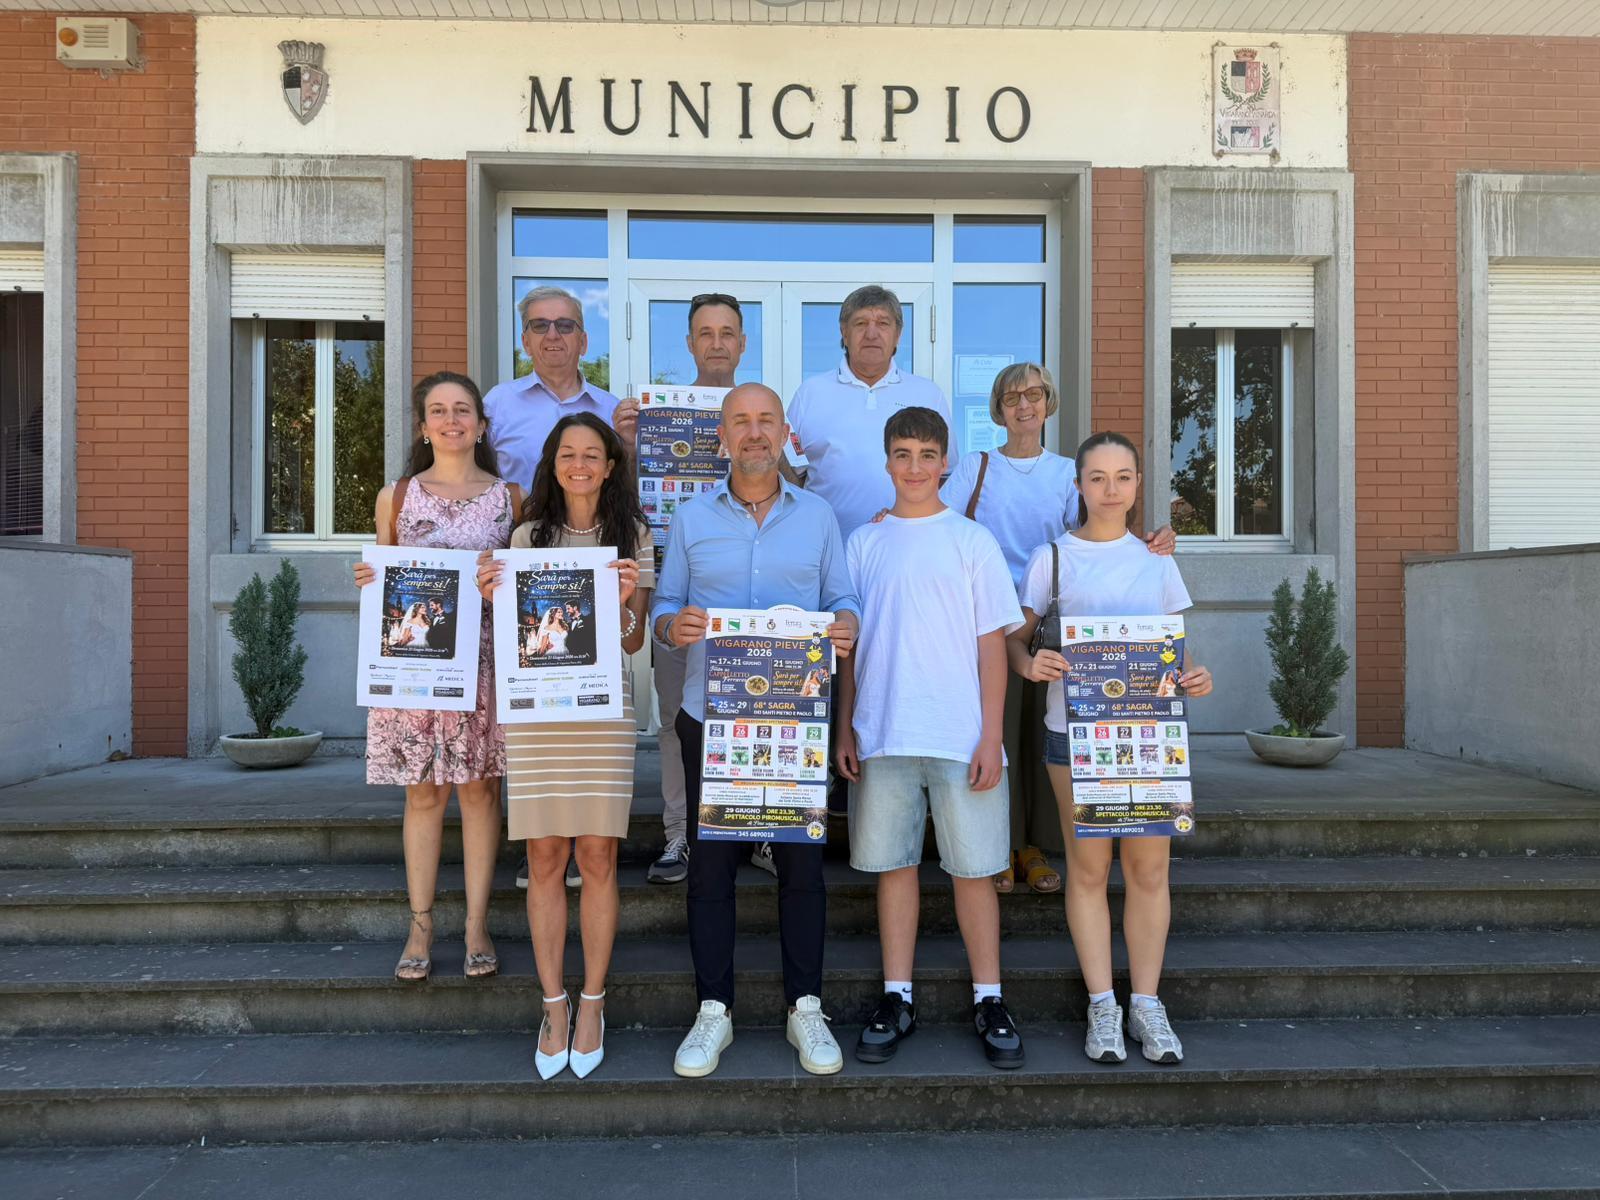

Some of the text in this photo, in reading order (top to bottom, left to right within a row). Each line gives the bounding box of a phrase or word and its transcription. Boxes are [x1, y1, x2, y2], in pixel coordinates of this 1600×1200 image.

[526, 76, 1031, 143] MUNICIPIO
[644, 410, 720, 420] VIGARANO PIEVE
[396, 567, 437, 581] Sarà per
[528, 569, 557, 585] Sarà
[402, 579, 432, 588] sempre
[536, 582, 567, 592] sempre
[714, 639, 806, 650] VIGARANO PIEVE
[1070, 644, 1159, 654] VIGARANO PIEVE
[747, 648, 772, 657] 2026
[1102, 652, 1127, 661] 2026
[773, 660, 783, 668] 21
[773, 671, 788, 680] Sarà
[1129, 673, 1144, 681] Sarà
[718, 701, 728, 709] 25
[737, 701, 747, 709] 29
[768, 702, 796, 710] SAGRA
[1096, 703, 1106, 711] 29
